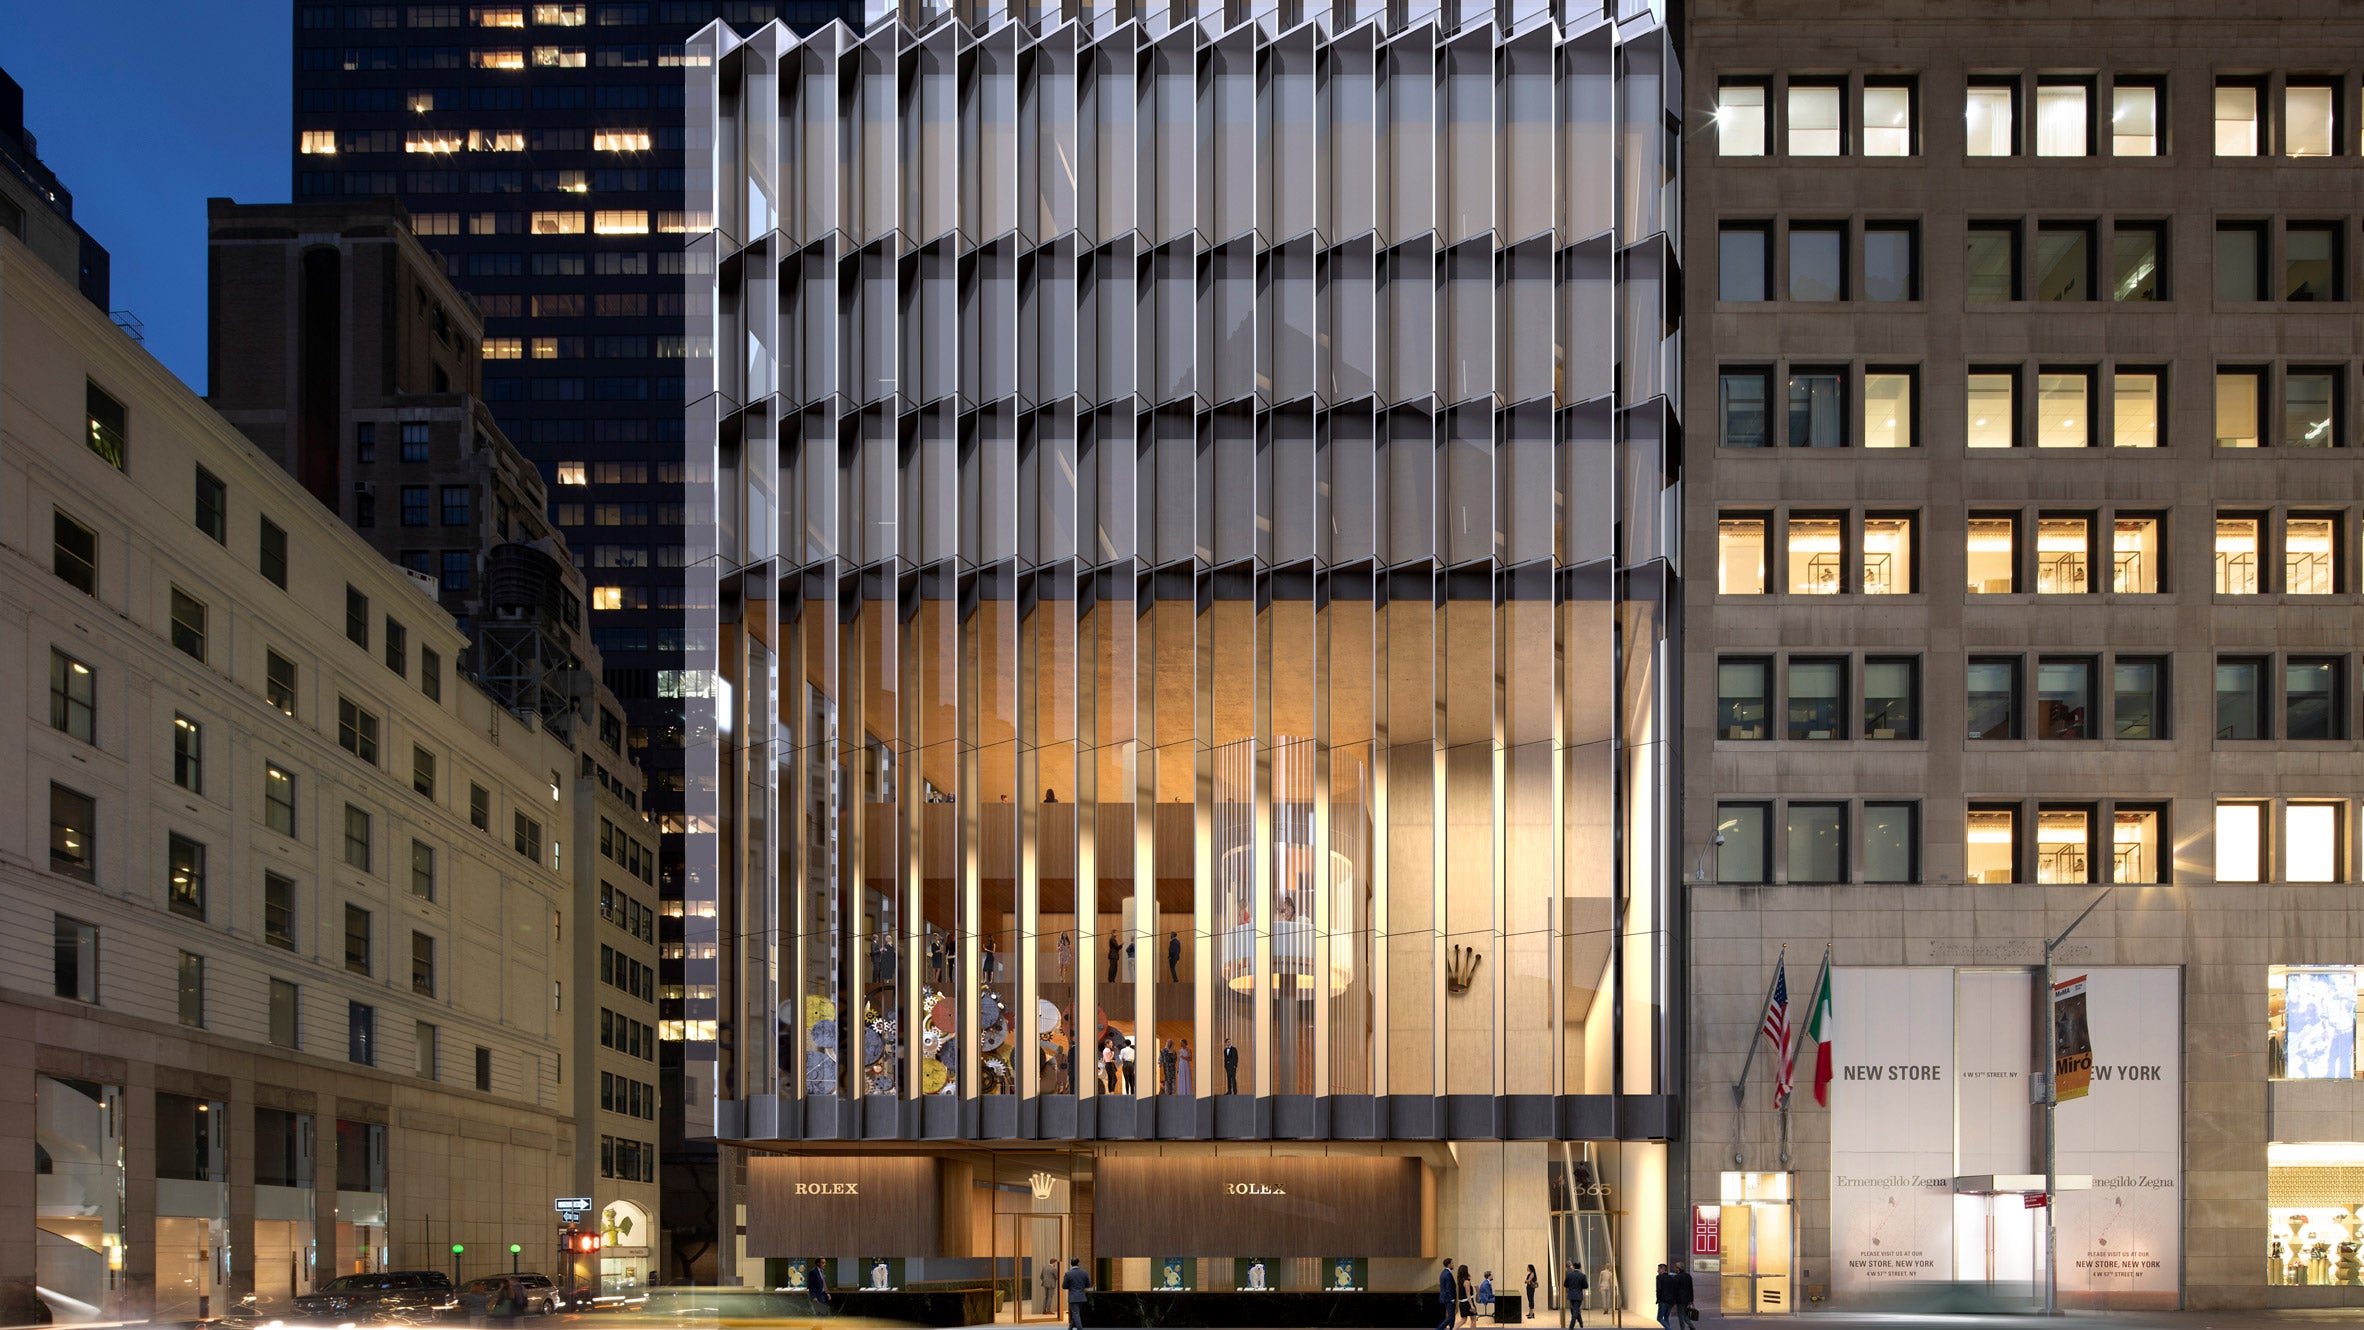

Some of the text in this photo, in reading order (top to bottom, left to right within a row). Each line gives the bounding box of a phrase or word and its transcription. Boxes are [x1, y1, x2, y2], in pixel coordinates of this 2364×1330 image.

[2056, 1052, 2092, 1076] Miró
[1844, 1066, 1941, 1080] NEW STORE
[2117, 1066, 2161, 1080] YORK
[794, 1182, 859, 1195] ROLEX
[1224, 1182, 1286, 1195] ROLEX
[1837, 1176, 1946, 1189] Ermenegildo Zegna
[2092, 1176, 2174, 1190] enegildo Zegna
[1574, 1183, 1612, 1196] 665
[1849, 1260, 1866, 1268] NEW
[1895, 1260, 1913, 1268] NEW
[1915, 1260, 1934, 1268] YORK
